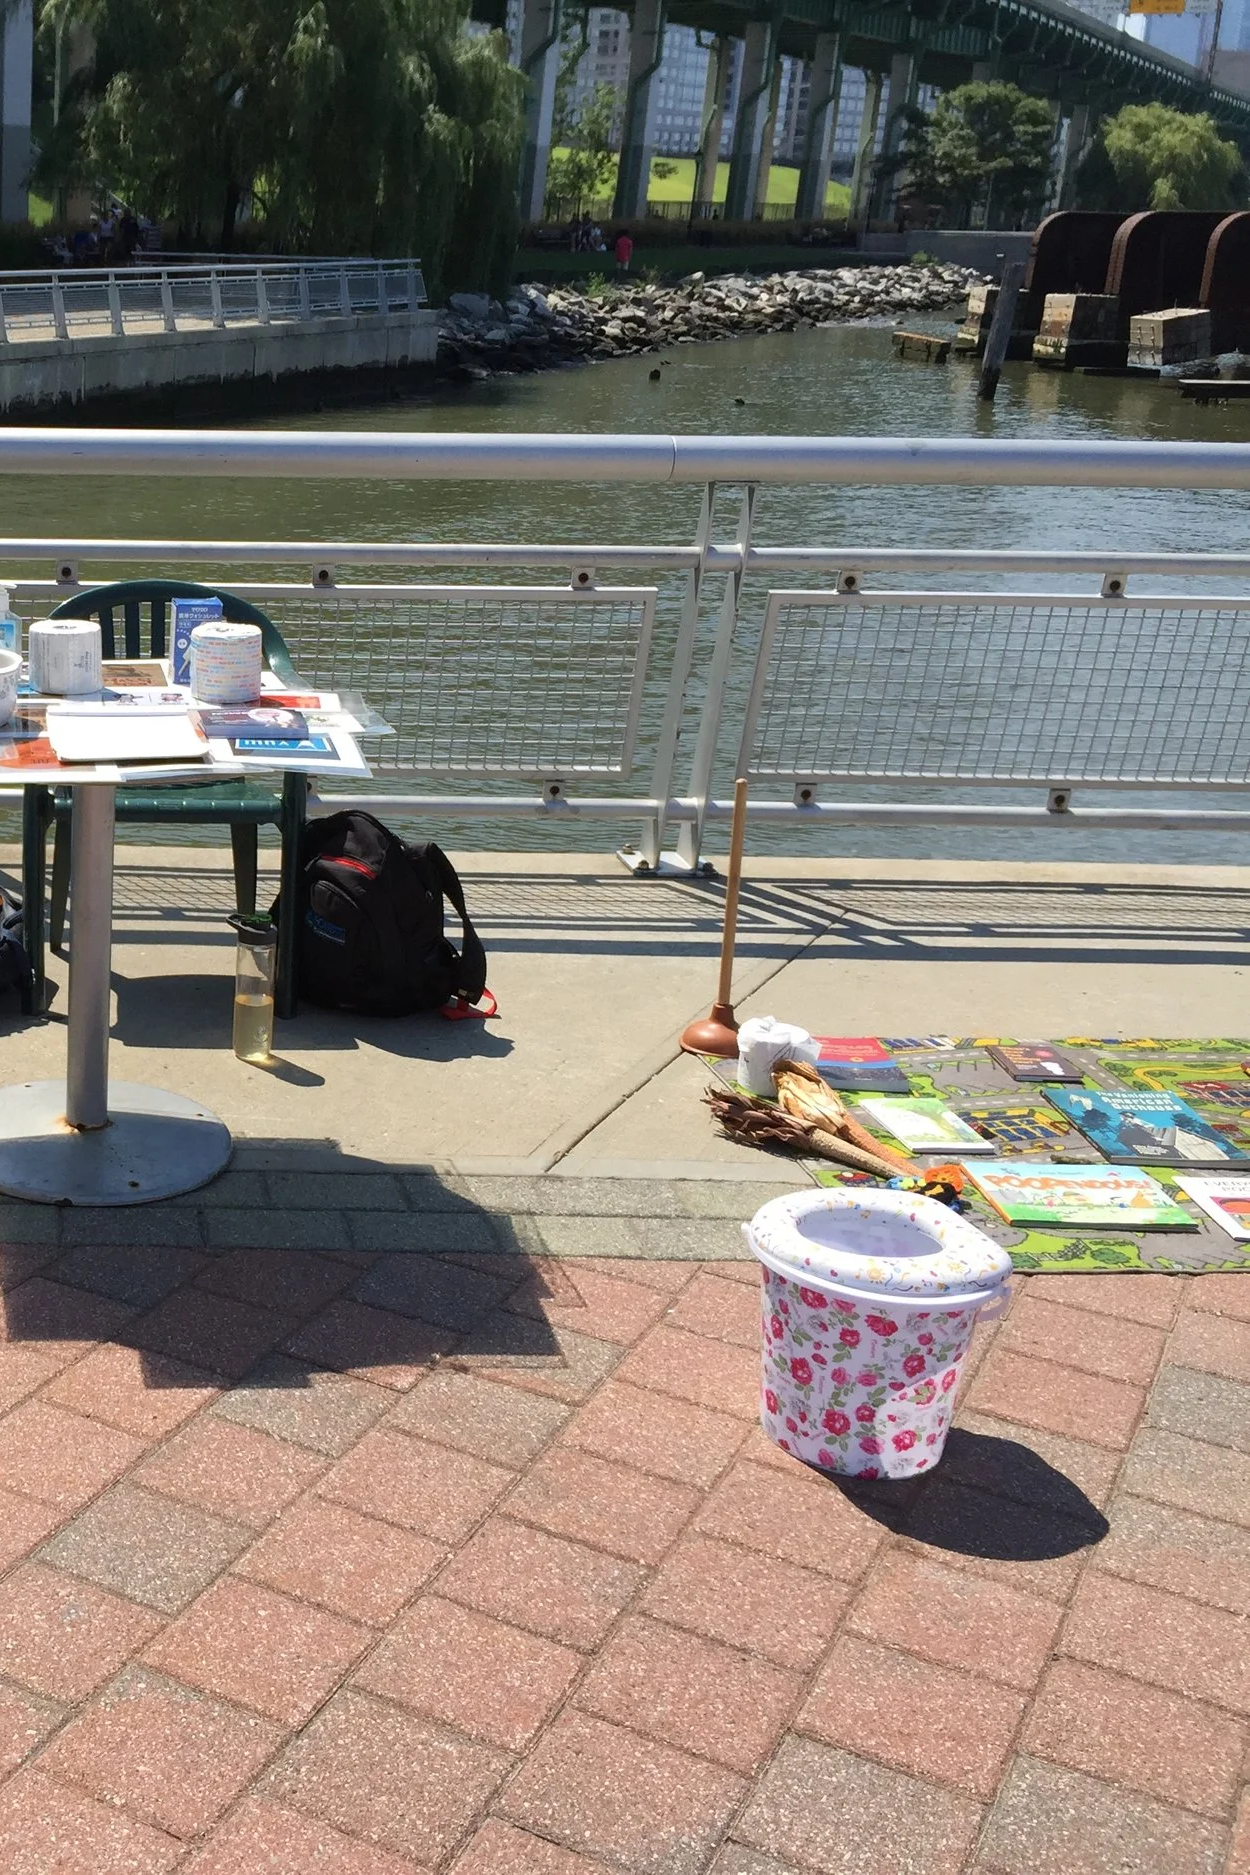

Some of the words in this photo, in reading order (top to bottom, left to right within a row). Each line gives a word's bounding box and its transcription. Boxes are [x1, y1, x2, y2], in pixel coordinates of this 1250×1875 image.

[1113, 1091, 1170, 1099] Vanishing
[1101, 1096, 1173, 1105] American
[1111, 1103, 1182, 1111] Outhouse
